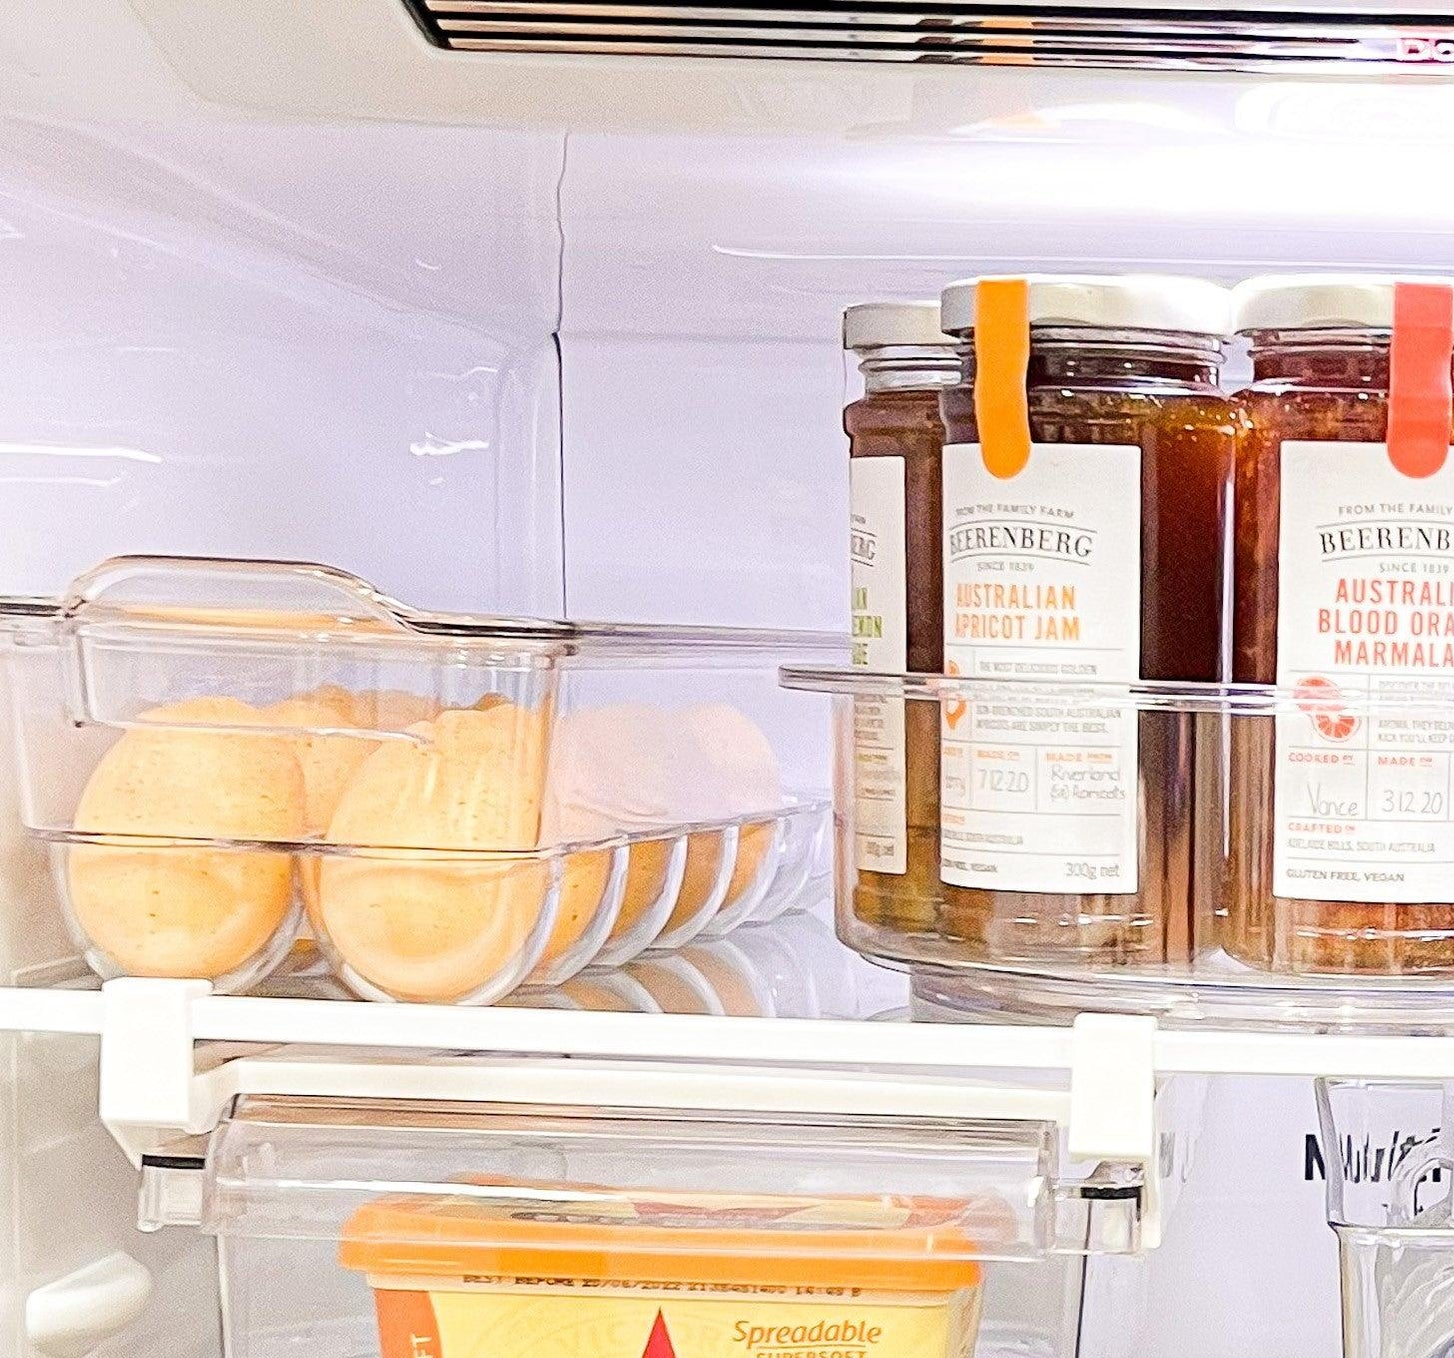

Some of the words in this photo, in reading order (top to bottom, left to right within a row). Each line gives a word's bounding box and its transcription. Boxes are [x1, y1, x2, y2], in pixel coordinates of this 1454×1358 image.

[1339, 506, 1375, 517] FROM
[1380, 503, 1404, 514] THE
[1409, 503, 1452, 516] FAMILY
[1379, 562, 1417, 573] SINCE
[956, 583, 1077, 610] AUSTRALIAN
[954, 612, 1027, 640] APRICOT
[1034, 616, 1081, 641] JAM
[1318, 608, 1399, 635] BLOOD
[1288, 752, 1340, 764] COOKED
[1378, 757, 1416, 766] MADE
[1287, 822, 1342, 834] CRAFTED
[1286, 868, 1327, 880] GLUTEN
[1364, 872, 1405, 883] VEGAN
[732, 1320, 882, 1350] Spreadable
